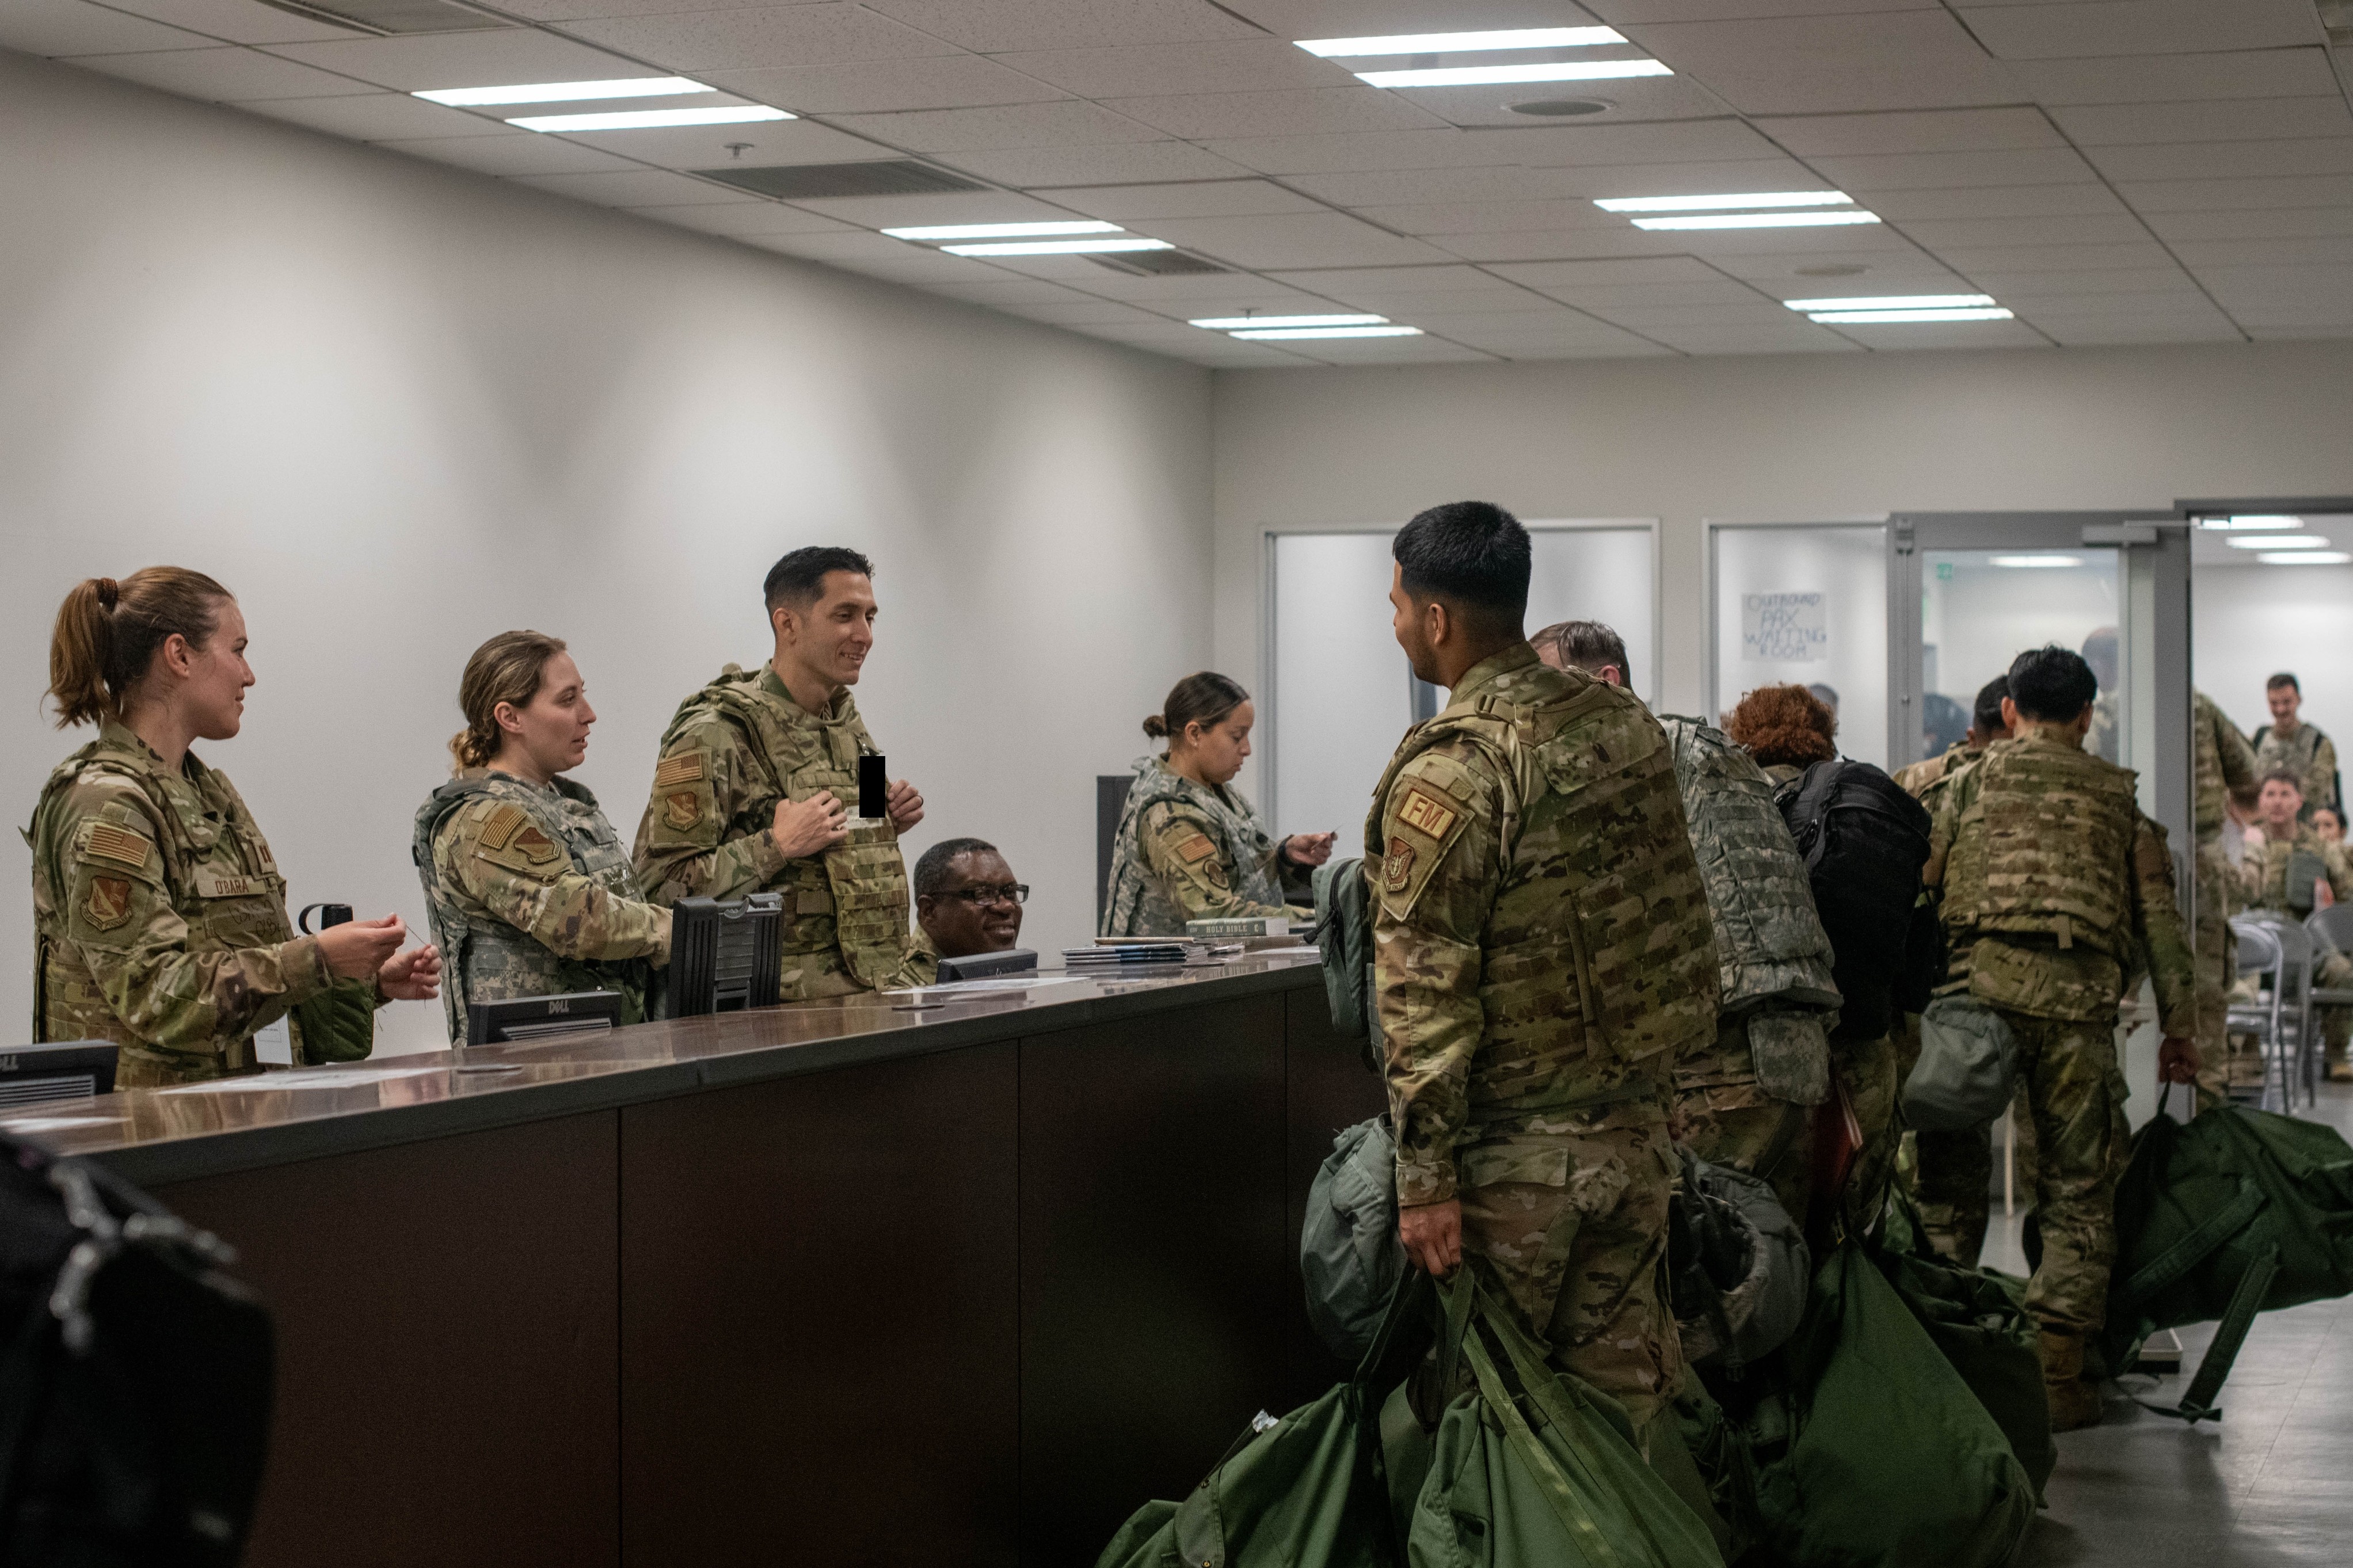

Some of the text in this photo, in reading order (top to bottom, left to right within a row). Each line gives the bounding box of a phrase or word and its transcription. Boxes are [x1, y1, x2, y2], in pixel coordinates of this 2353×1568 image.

[1761, 607, 1799, 628] PAX
[1744, 628, 1827, 645] WAITING
[1760, 643, 1806, 658] ROOM
[1407, 796, 1445, 831] FM
[215, 878, 249, 894] O'BARA
[1226, 925, 1247, 933] BIBLE
[549, 999, 569, 1014] DELL
